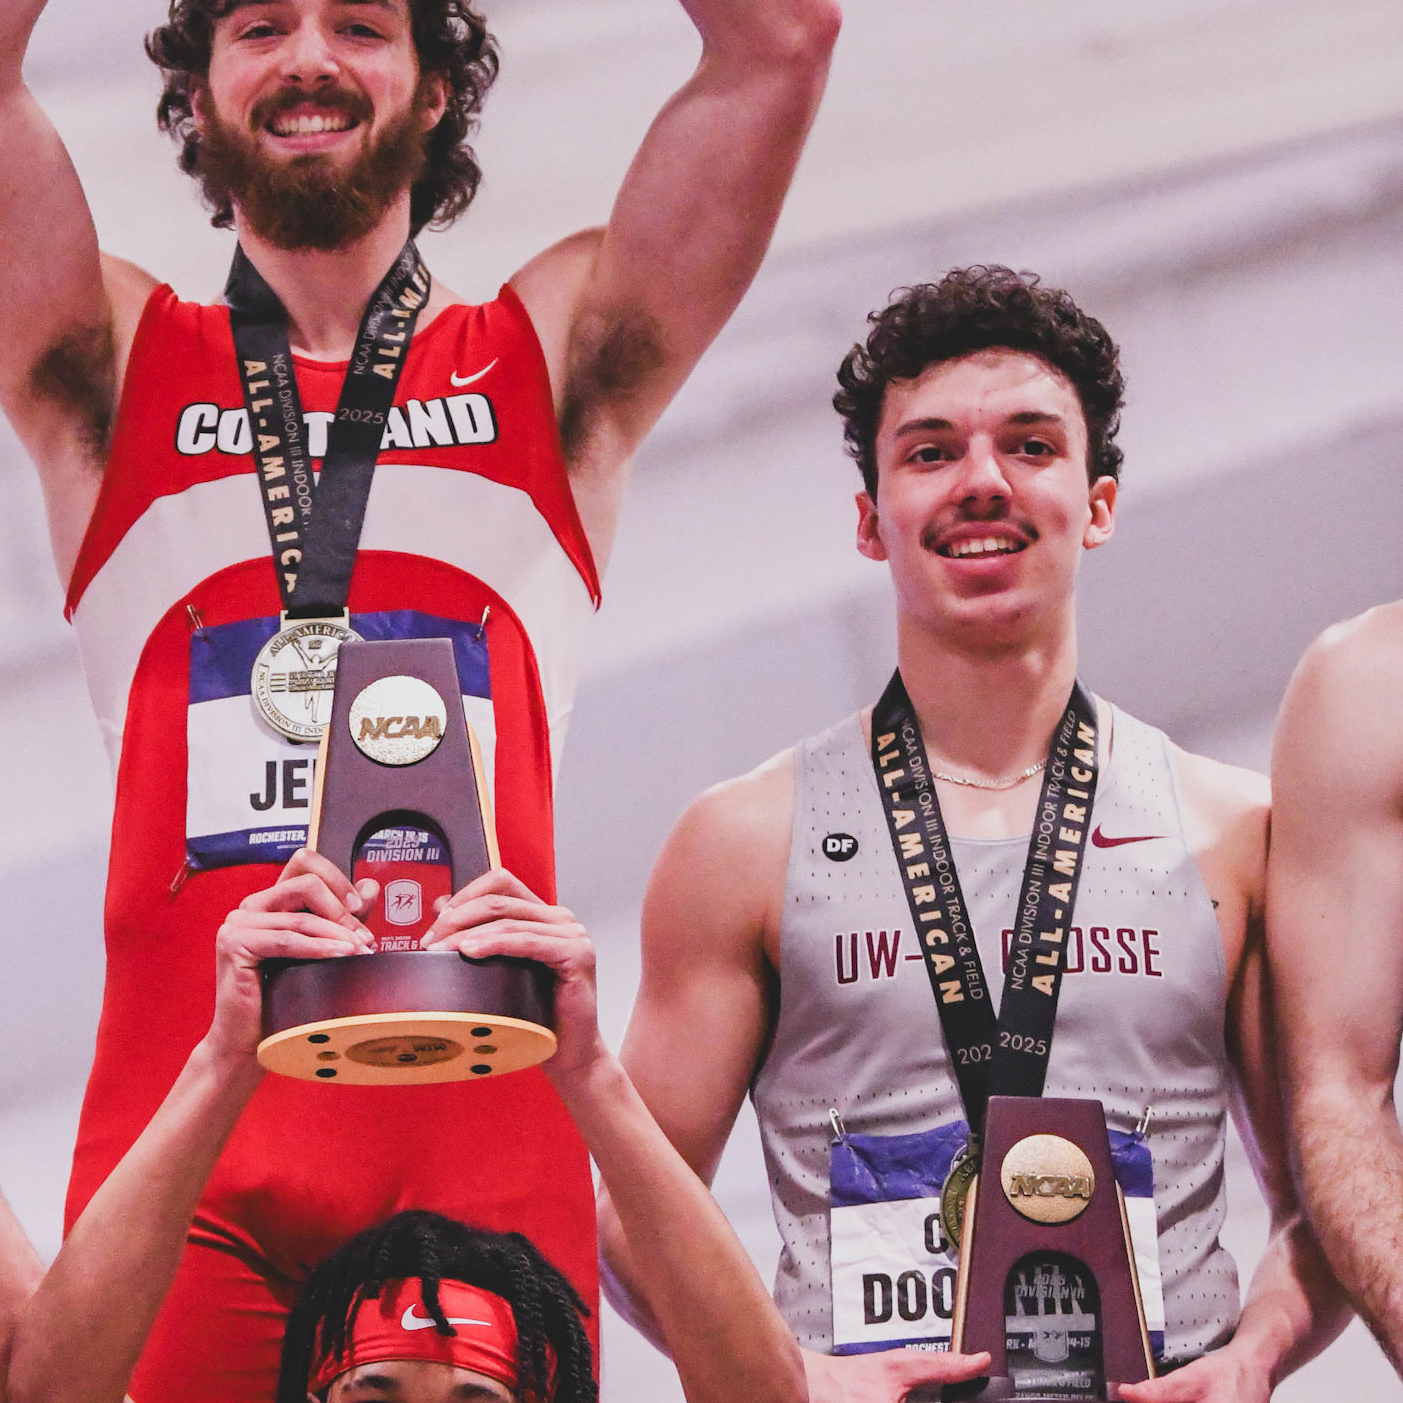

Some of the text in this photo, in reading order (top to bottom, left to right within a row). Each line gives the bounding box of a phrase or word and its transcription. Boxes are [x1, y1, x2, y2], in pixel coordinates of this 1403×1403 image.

[272, 353, 289, 388] NCAA
[278, 389, 299, 440] DIVISION
[339, 408, 384, 424] 2025
[358, 716, 443, 742] NCAA
[366, 849, 424, 863] DIVISION
[826, 836, 855, 853] DF
[1011, 709, 1077, 991] NCAA DIVISION III INDOOR TRACK & FIELD
[877, 731, 965, 1005] ALL-AMERICAN
[1031, 721, 1096, 997] ALL-AMERICAN
[908, 756, 983, 1000] DIVISION III INDOOR TRACK & FIELD
[380, 941, 410, 951] TRACK
[998, 1031, 1048, 1056] 2025
[1010, 1174, 1092, 1198] NCAA
